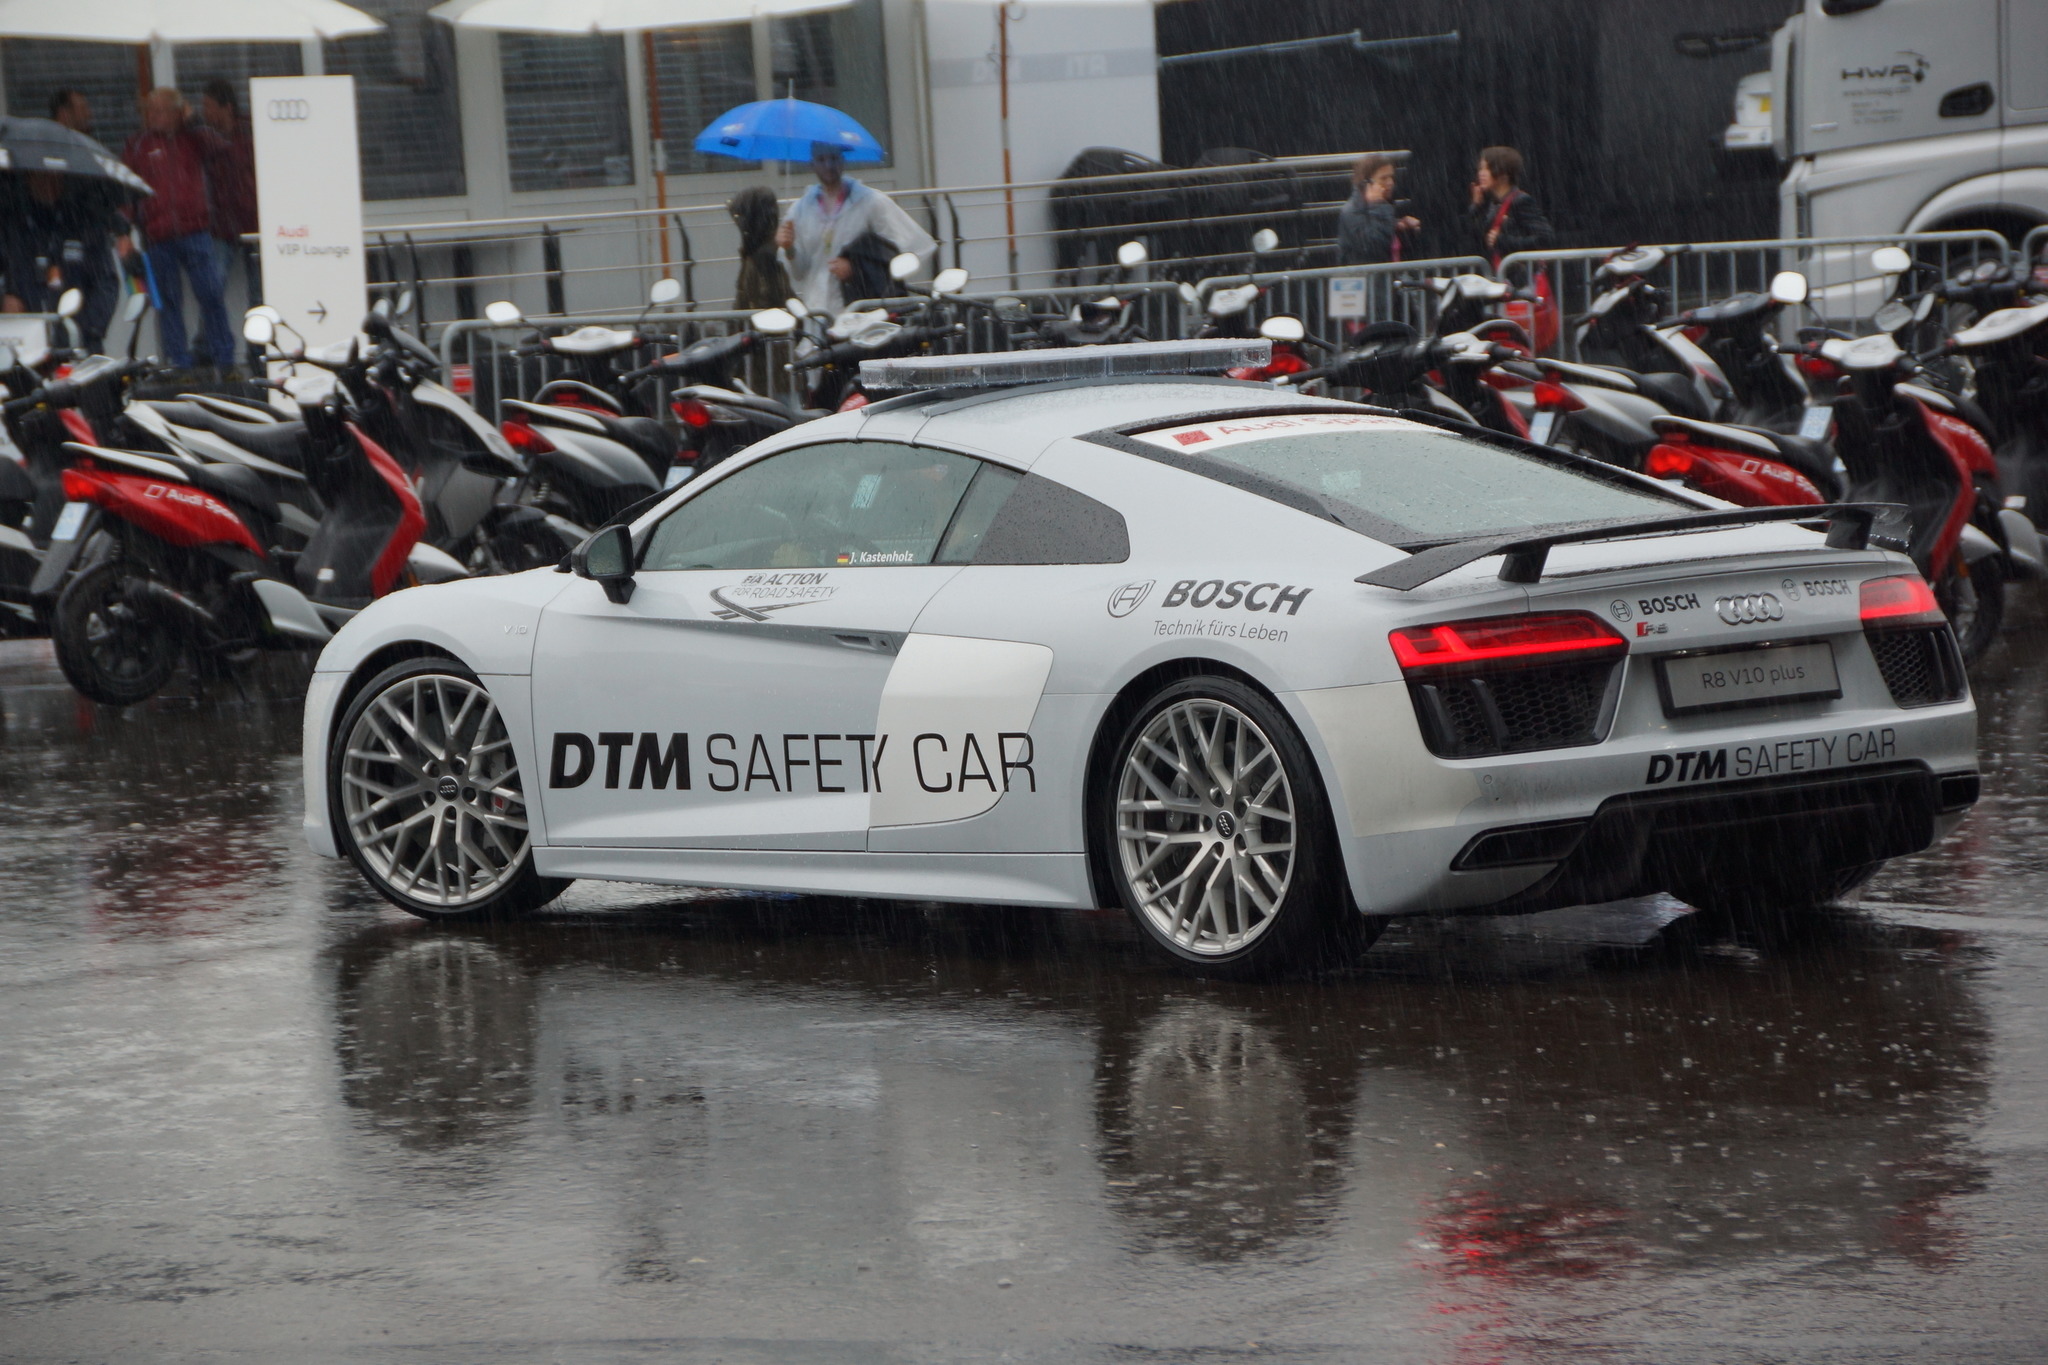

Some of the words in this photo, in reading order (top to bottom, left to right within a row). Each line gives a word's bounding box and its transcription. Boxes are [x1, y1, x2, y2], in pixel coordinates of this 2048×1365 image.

[277, 225, 309, 238] Audi
[277, 244, 302, 255] VIP
[304, 244, 350, 258] Lounge
[1217, 419, 1299, 435] Audi
[1761, 464, 1795, 483] Audi
[165, 488, 203, 506] Audi
[849, 552, 857, 564] J.
[859, 550, 914, 563] Kastenholz
[763, 573, 828, 586] ACTION
[1803, 579, 1852, 597] BOSCH
[731, 587, 753, 597] FOR
[750, 586, 788, 599] ROAD
[786, 586, 841, 599] SAFETY
[1161, 579, 1315, 616] BOSCH
[1638, 593, 1701, 616] BOSCH
[1153, 619, 1206, 637] Technik
[1207, 620, 1237, 637] fürs
[1239, 621, 1289, 643] Leben
[1702, 671, 1727, 689] R8
[1728, 667, 1766, 686] V10
[1769, 664, 1806, 685] plus
[549, 732, 691, 790] DTM
[706, 733, 889, 793] SAFETY
[912, 733, 1037, 793] CAR
[1645, 749, 1728, 785] DTM
[1735, 736, 1837, 777] SAFETY
[1846, 728, 1897, 763] CAR
